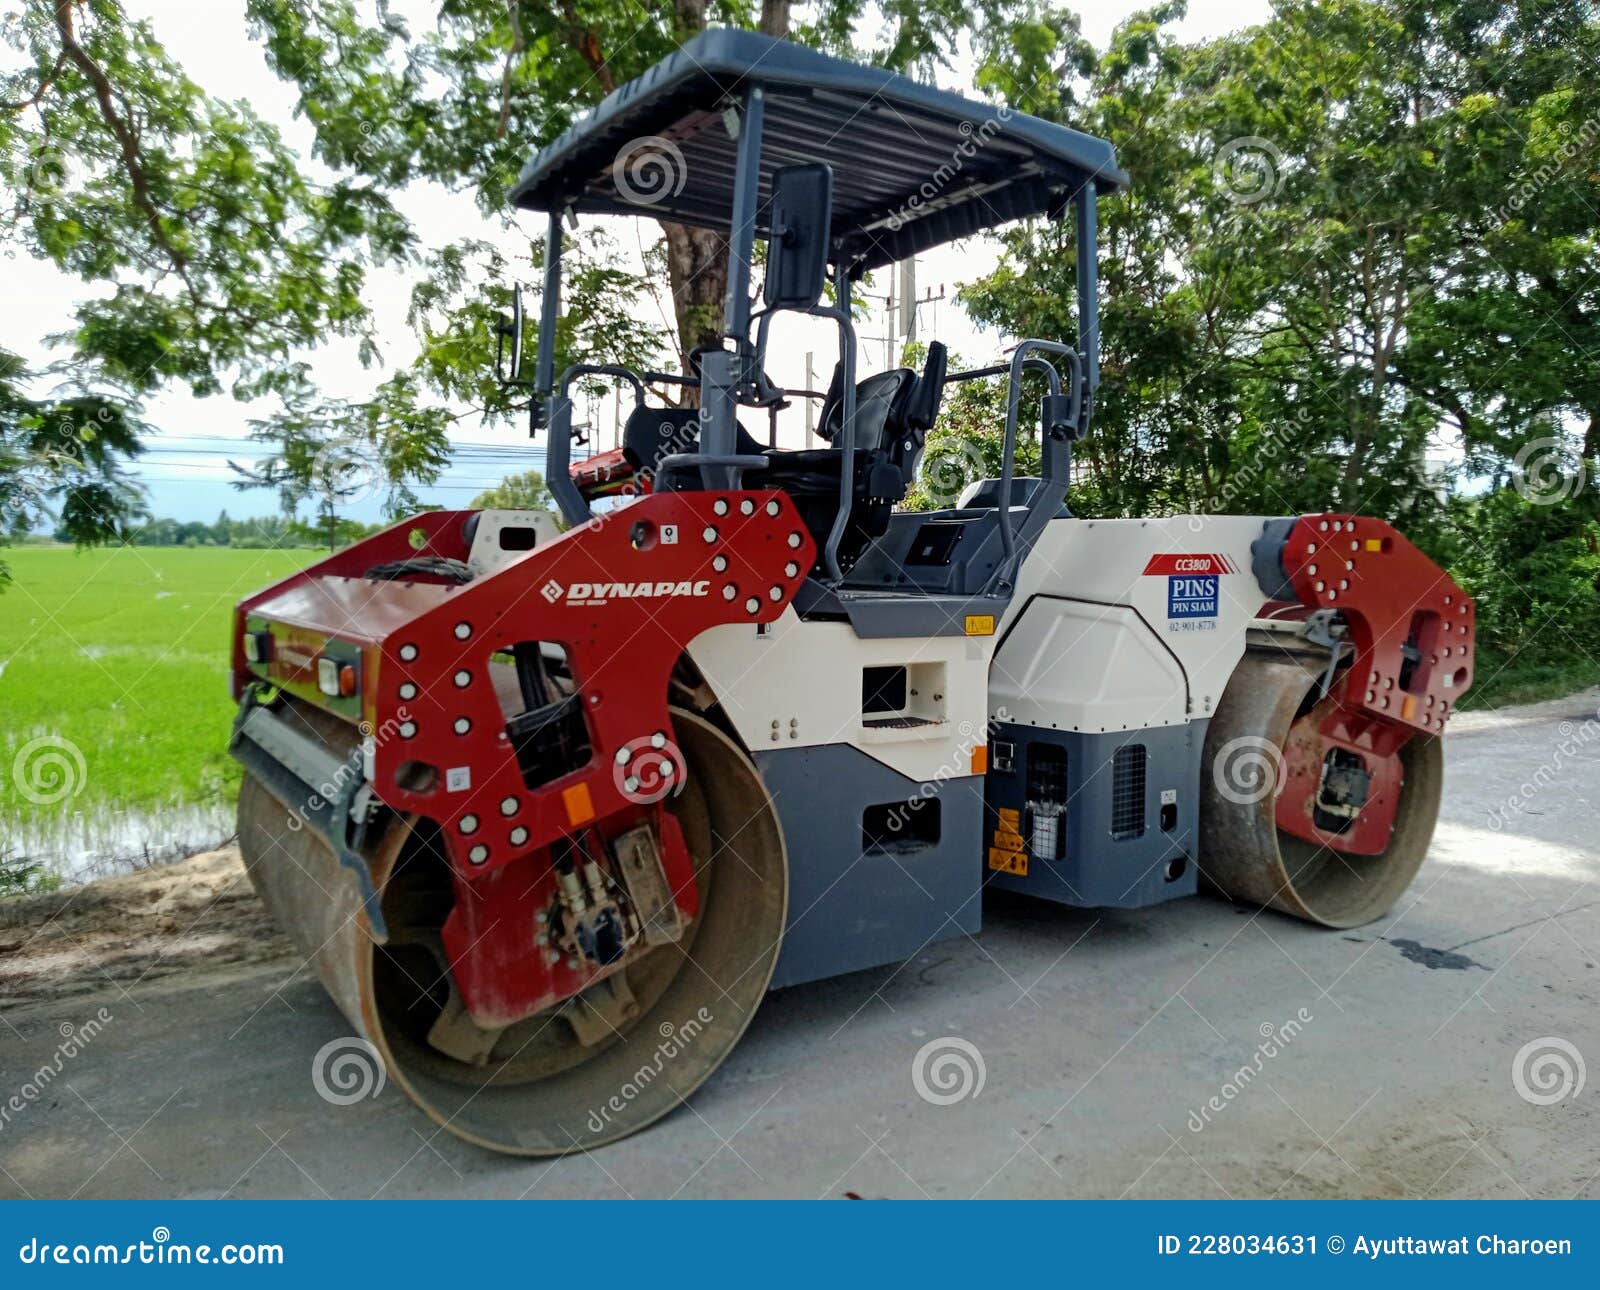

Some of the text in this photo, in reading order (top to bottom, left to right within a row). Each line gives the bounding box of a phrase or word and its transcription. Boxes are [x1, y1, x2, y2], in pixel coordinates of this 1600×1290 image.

[1174, 559, 1211, 571] CC3800
[566, 581, 711, 599] DYNAPAC
[1172, 579, 1215, 597] PINS
[1172, 602, 1214, 613] PIN SIAM
